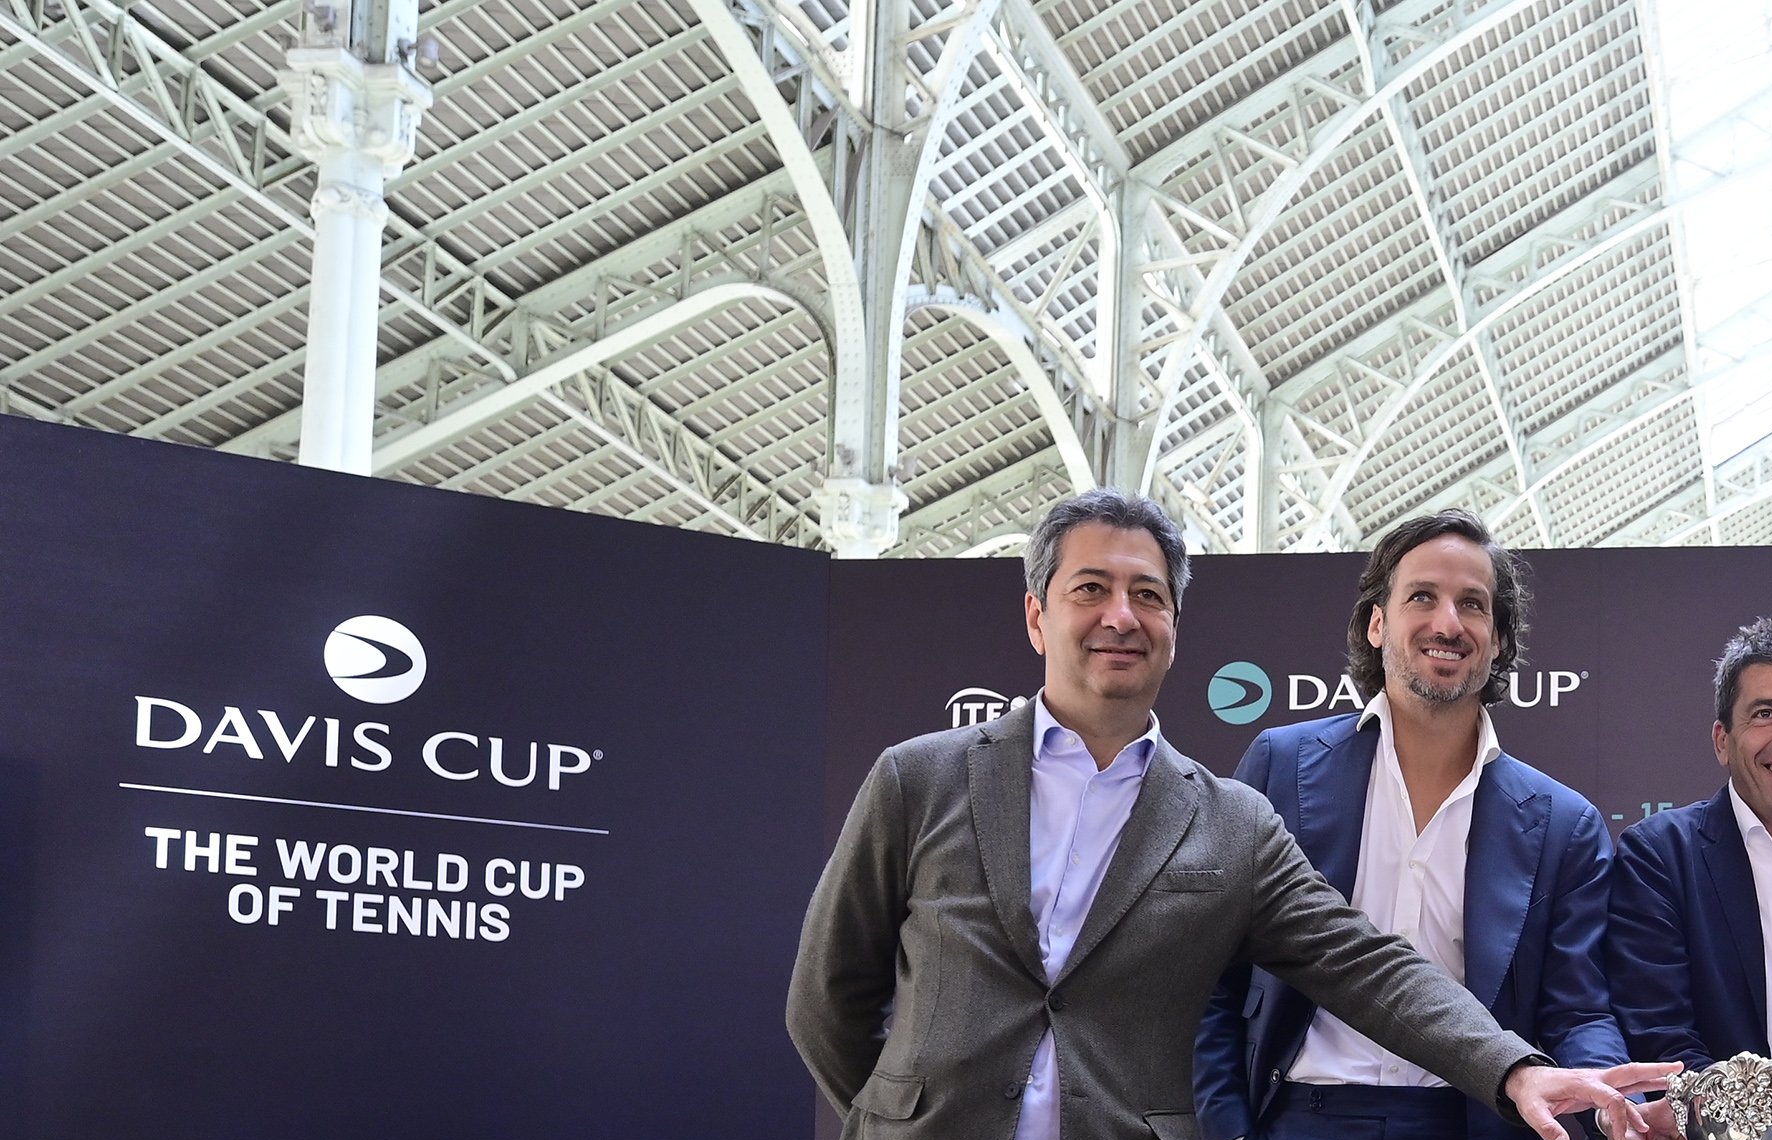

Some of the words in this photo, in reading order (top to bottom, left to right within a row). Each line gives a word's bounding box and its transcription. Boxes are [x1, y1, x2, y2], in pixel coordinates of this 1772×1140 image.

[134, 695, 393, 772] DAVIS
[144, 826, 259, 876] THE
[275, 838, 469, 891] WORLD
[483, 858, 585, 902] CUP
[228, 882, 301, 926] OF
[315, 888, 512, 943] TENNIS
